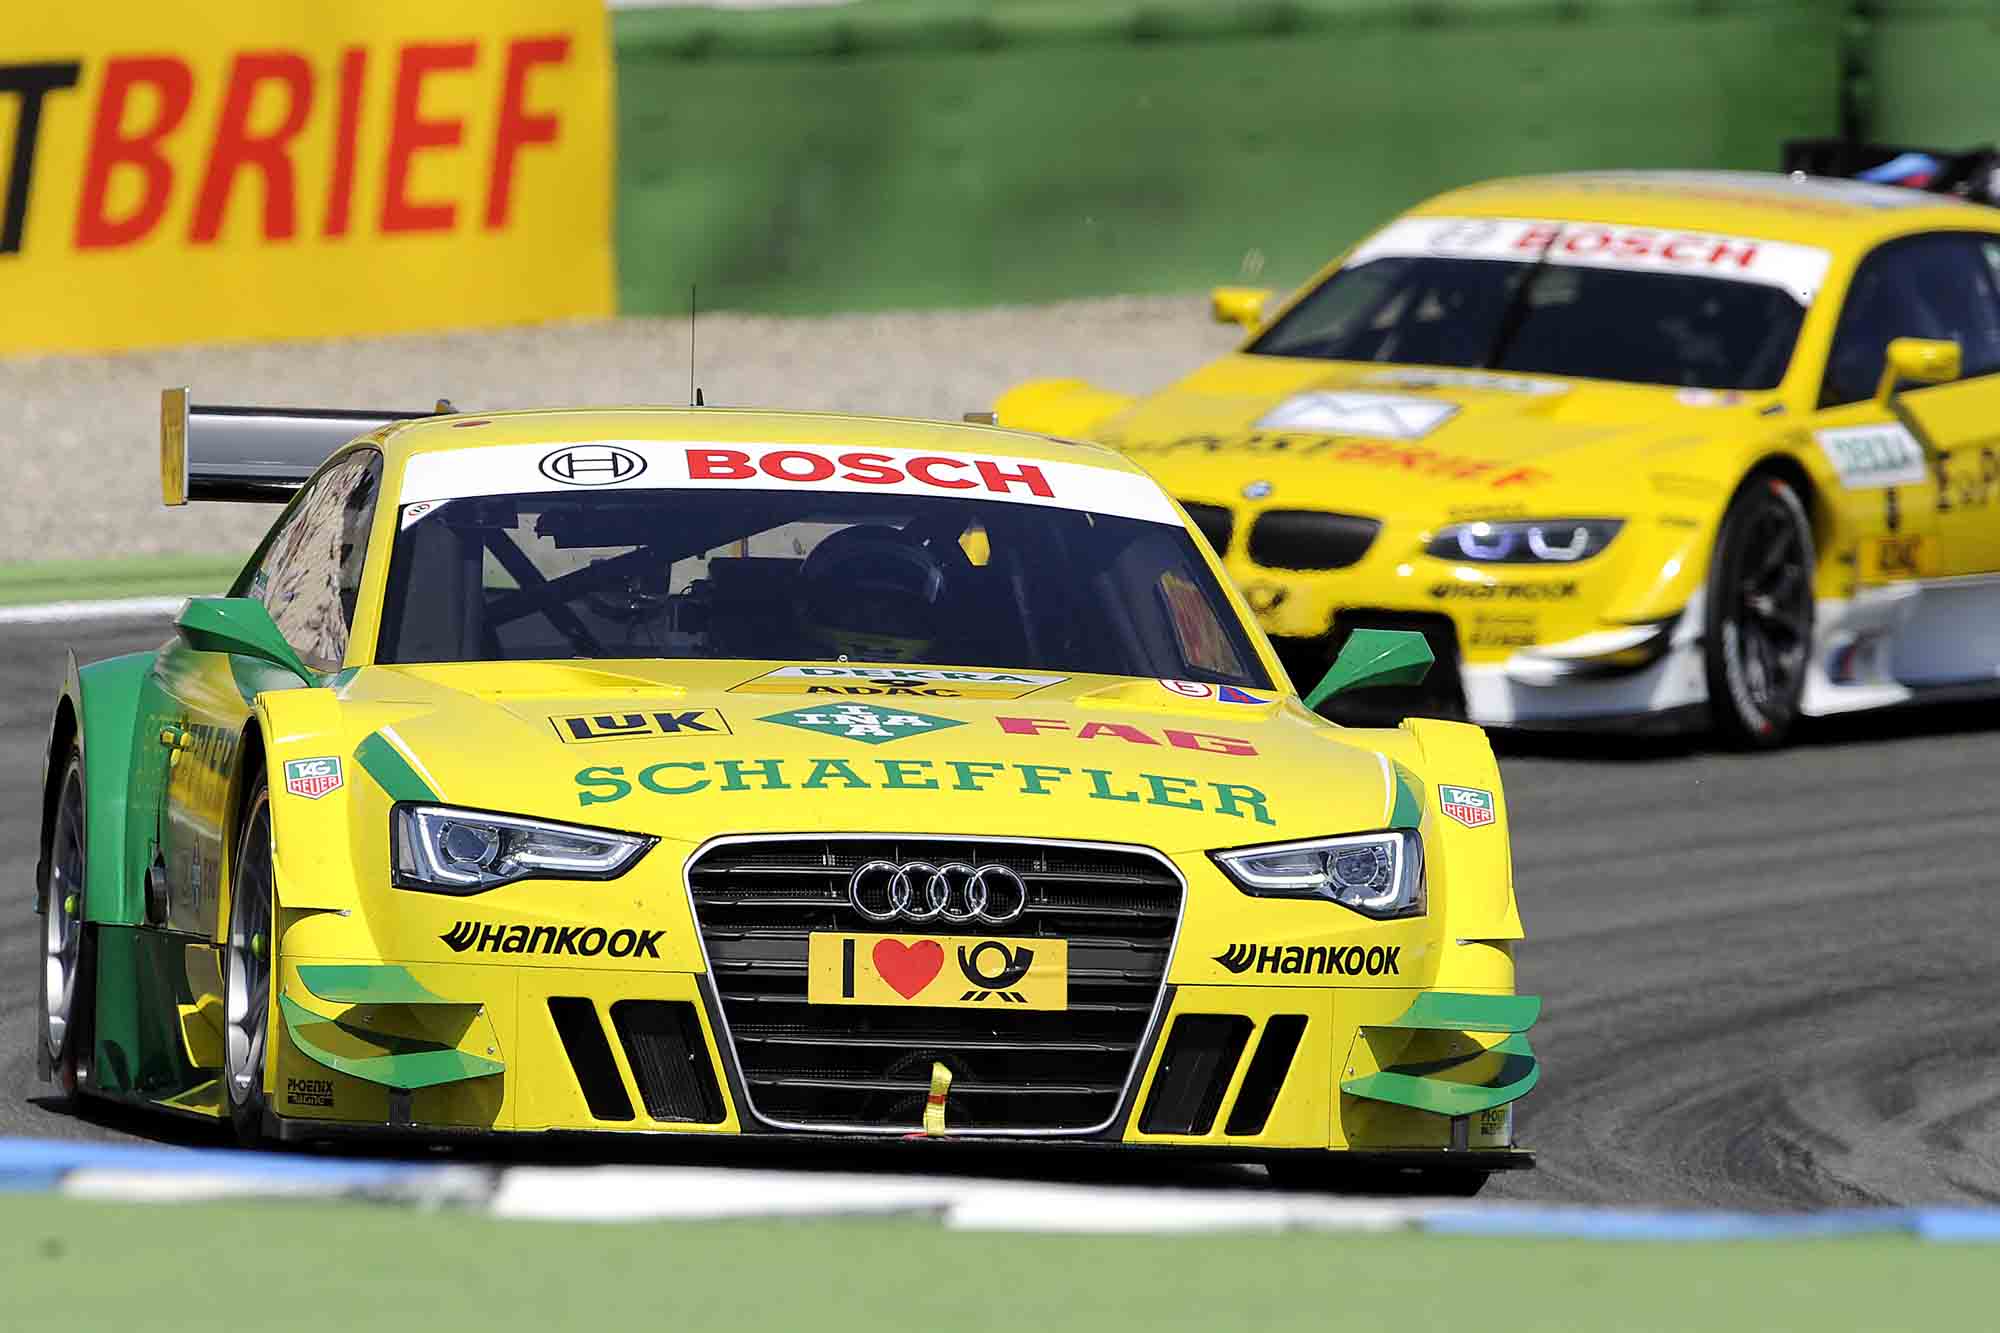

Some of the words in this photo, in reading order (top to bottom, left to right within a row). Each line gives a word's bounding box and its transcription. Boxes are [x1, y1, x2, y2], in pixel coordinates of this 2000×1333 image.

[1512, 224, 1757, 267] BOSCH
[685, 449, 1056, 498] BOSCH
[799, 667, 1042, 684] DEKRA
[806, 685, 962, 697] ADAC
[995, 716, 1259, 756] FAG
[294, 761, 331, 777] TAG
[289, 776, 337, 795] HEUER
[574, 758, 1277, 826] SCHAEFFLER
[1449, 789, 1485, 807] TAG
[1445, 804, 1490, 823] HEUER
